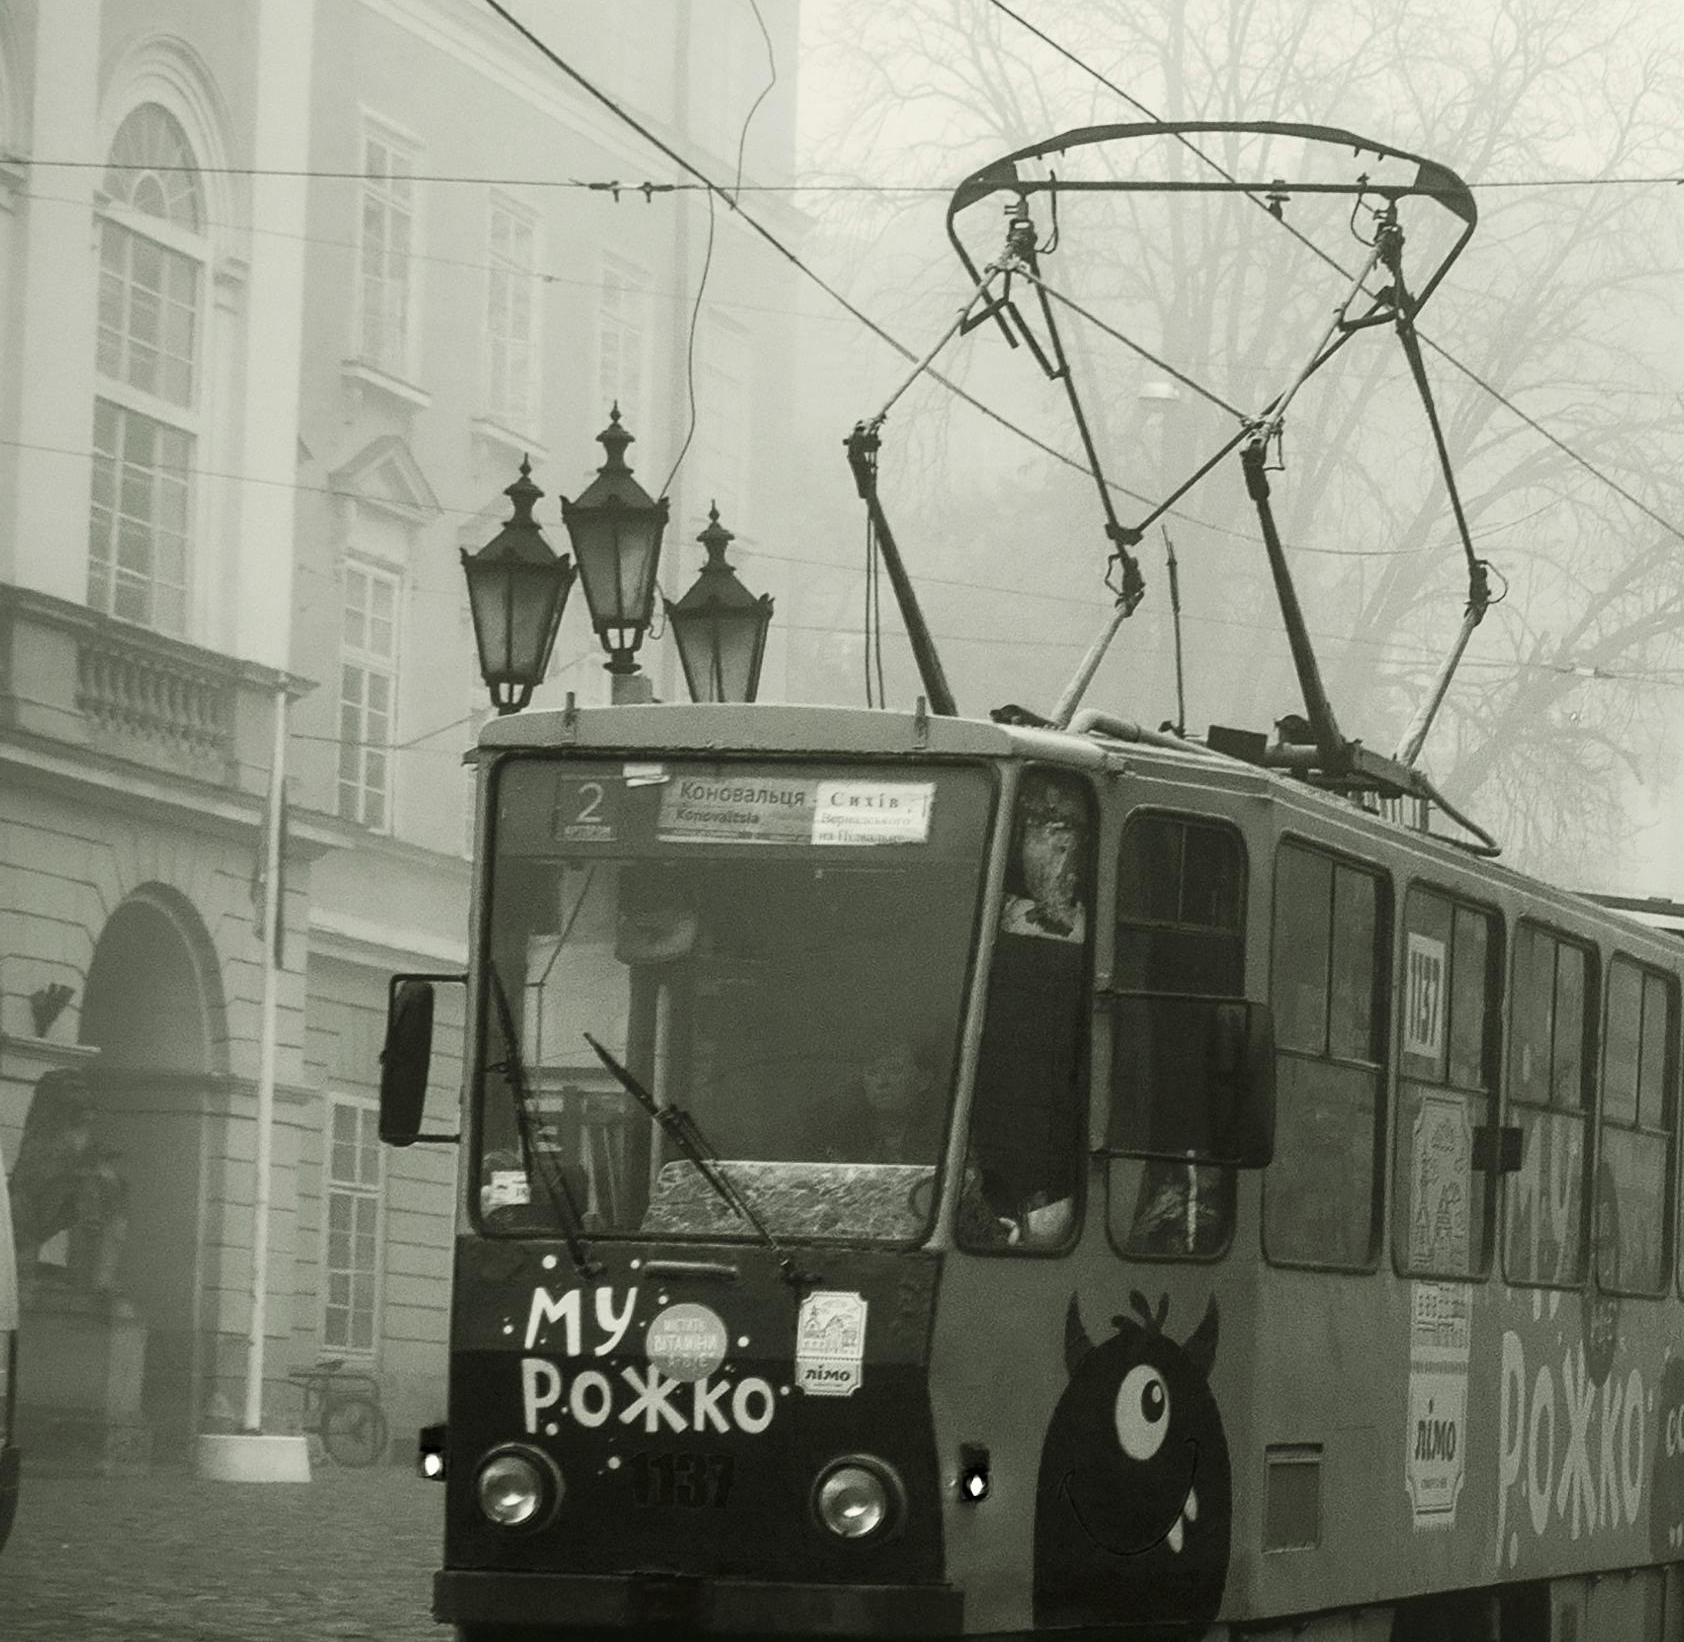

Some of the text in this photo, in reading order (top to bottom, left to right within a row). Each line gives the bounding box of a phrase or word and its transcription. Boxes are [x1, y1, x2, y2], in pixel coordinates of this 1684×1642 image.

[576, 781, 604, 823] 2
[680, 781, 806, 807] Коновальця
[523, 1286, 638, 1356] МУ
[521, 1358, 775, 1434] РОЖКО
[1496, 1329, 1645, 1566] РОЖКО
